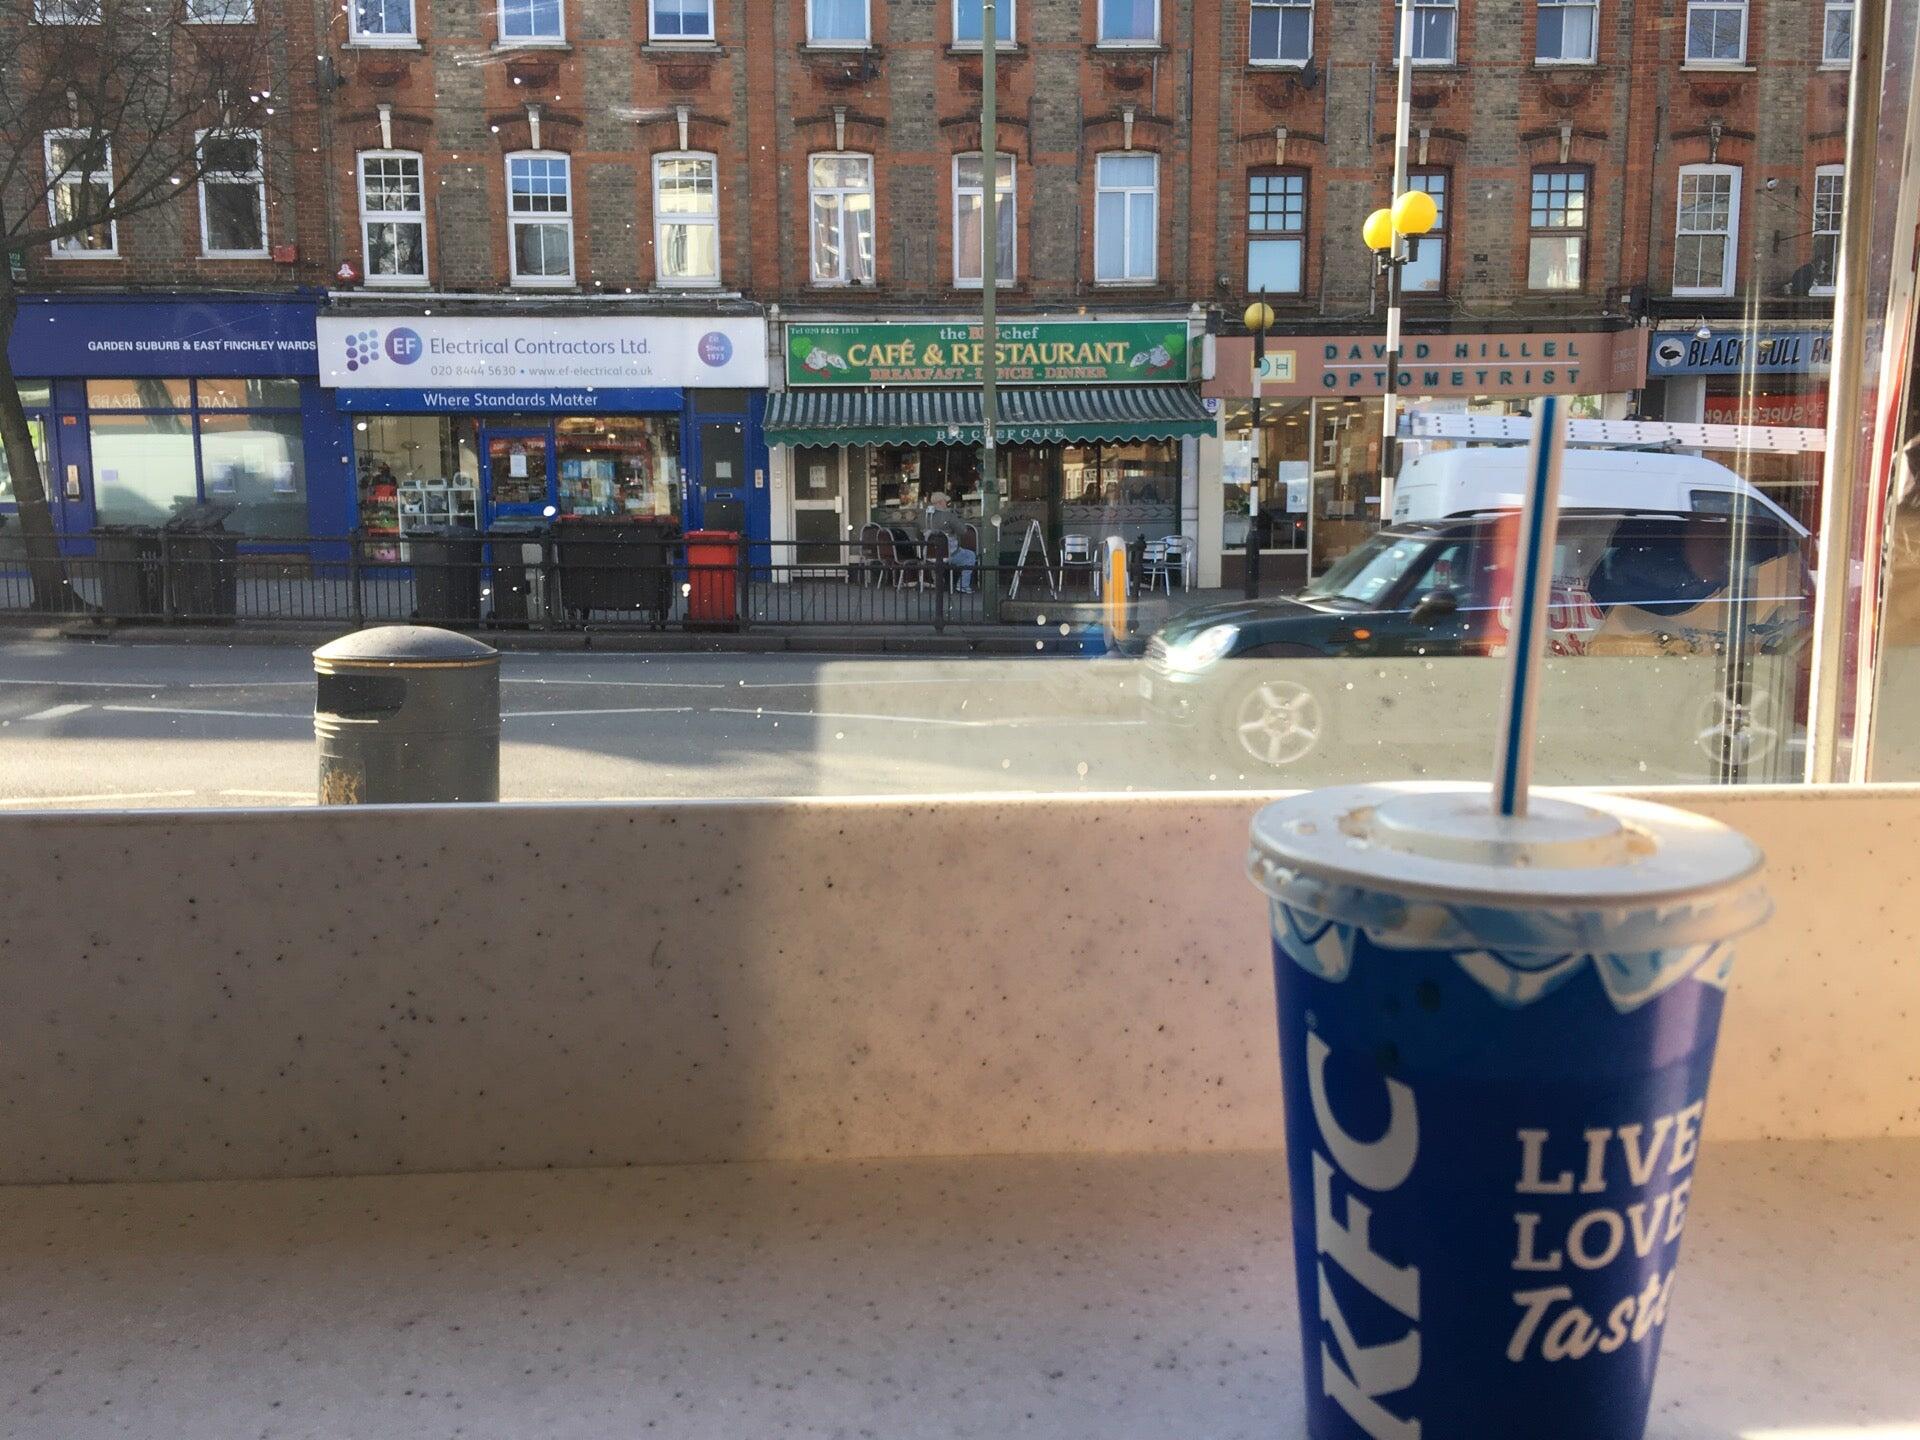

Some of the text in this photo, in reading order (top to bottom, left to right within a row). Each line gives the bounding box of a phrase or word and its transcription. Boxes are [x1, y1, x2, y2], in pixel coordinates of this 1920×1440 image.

[940, 327, 967, 340] the
[1001, 326, 1040, 340] chef
[88, 340, 316, 351] GARDEN SUBURB & EAST FINCHLEY WARDS
[391, 337, 417, 355] EF
[430, 337, 651, 355] Electrical Contractors Ltd.
[847, 338, 1130, 366] CAFÉ & RESTAURANT
[1324, 341, 1580, 360] DAVID HILLEL
[1687, 337, 1750, 367] BLACK
[431, 364, 653, 377] 020 8444 5630 www.ef-electrical.co.uk
[869, 366, 1108, 381] BREAKFAST LNCH DINNER
[1322, 369, 1582, 388] OPTOMETRIST
[423, 393, 598, 407] Where Standards Matter
[971, 429, 1016, 439] CEF
[1514, 1100, 1704, 1195] LIVE
[1510, 1177, 1693, 1272] LOVE
[1306, 1031, 1423, 1440] KFC
